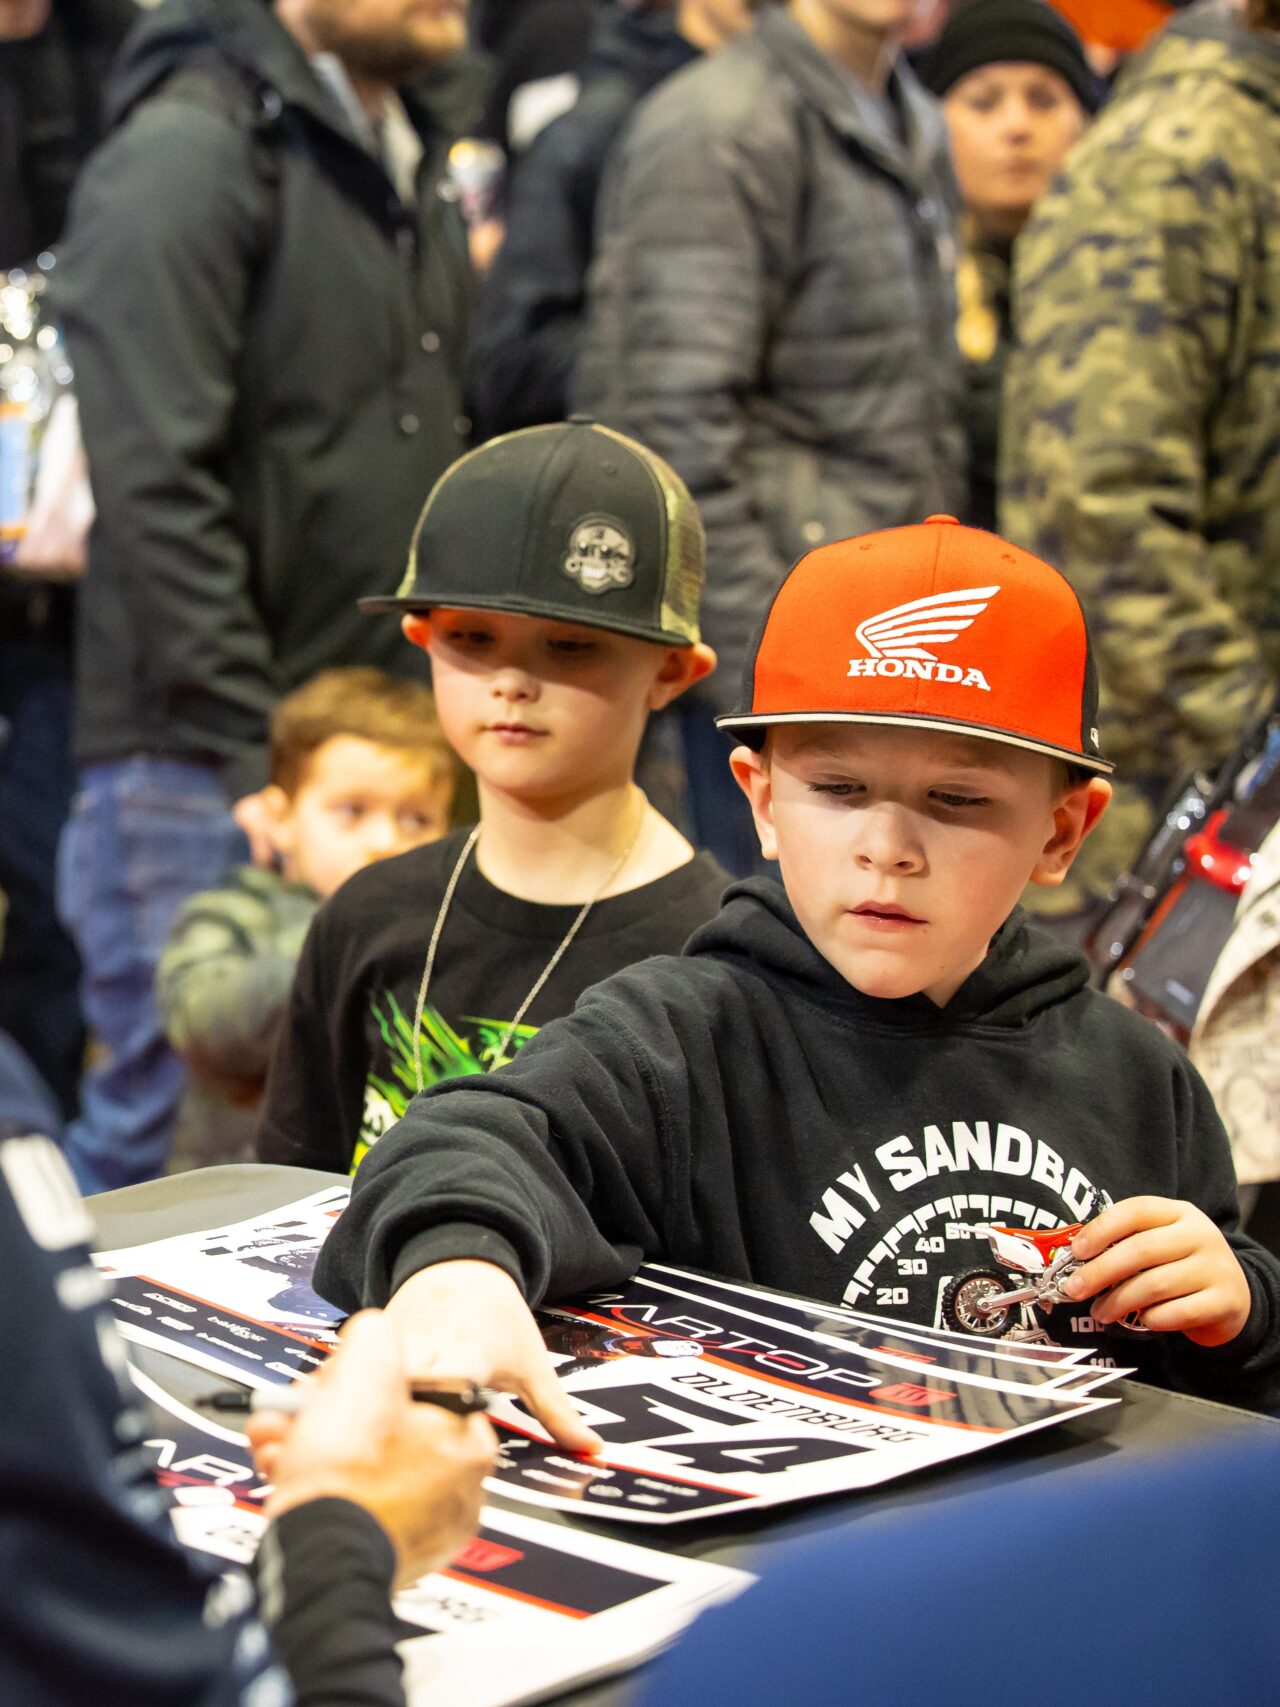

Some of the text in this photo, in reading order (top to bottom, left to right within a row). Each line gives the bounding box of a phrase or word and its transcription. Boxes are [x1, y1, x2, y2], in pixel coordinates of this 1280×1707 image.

[846, 658, 992, 691] HONDA
[809, 1120, 1096, 1255] MY SANDBO
[914, 1236, 946, 1254] 40
[896, 1258, 928, 1276] 30
[876, 1287, 909, 1306] 20
[582, 1293, 883, 1389] ARTOP
[670, 1371, 930, 1443] OLDENBURG
